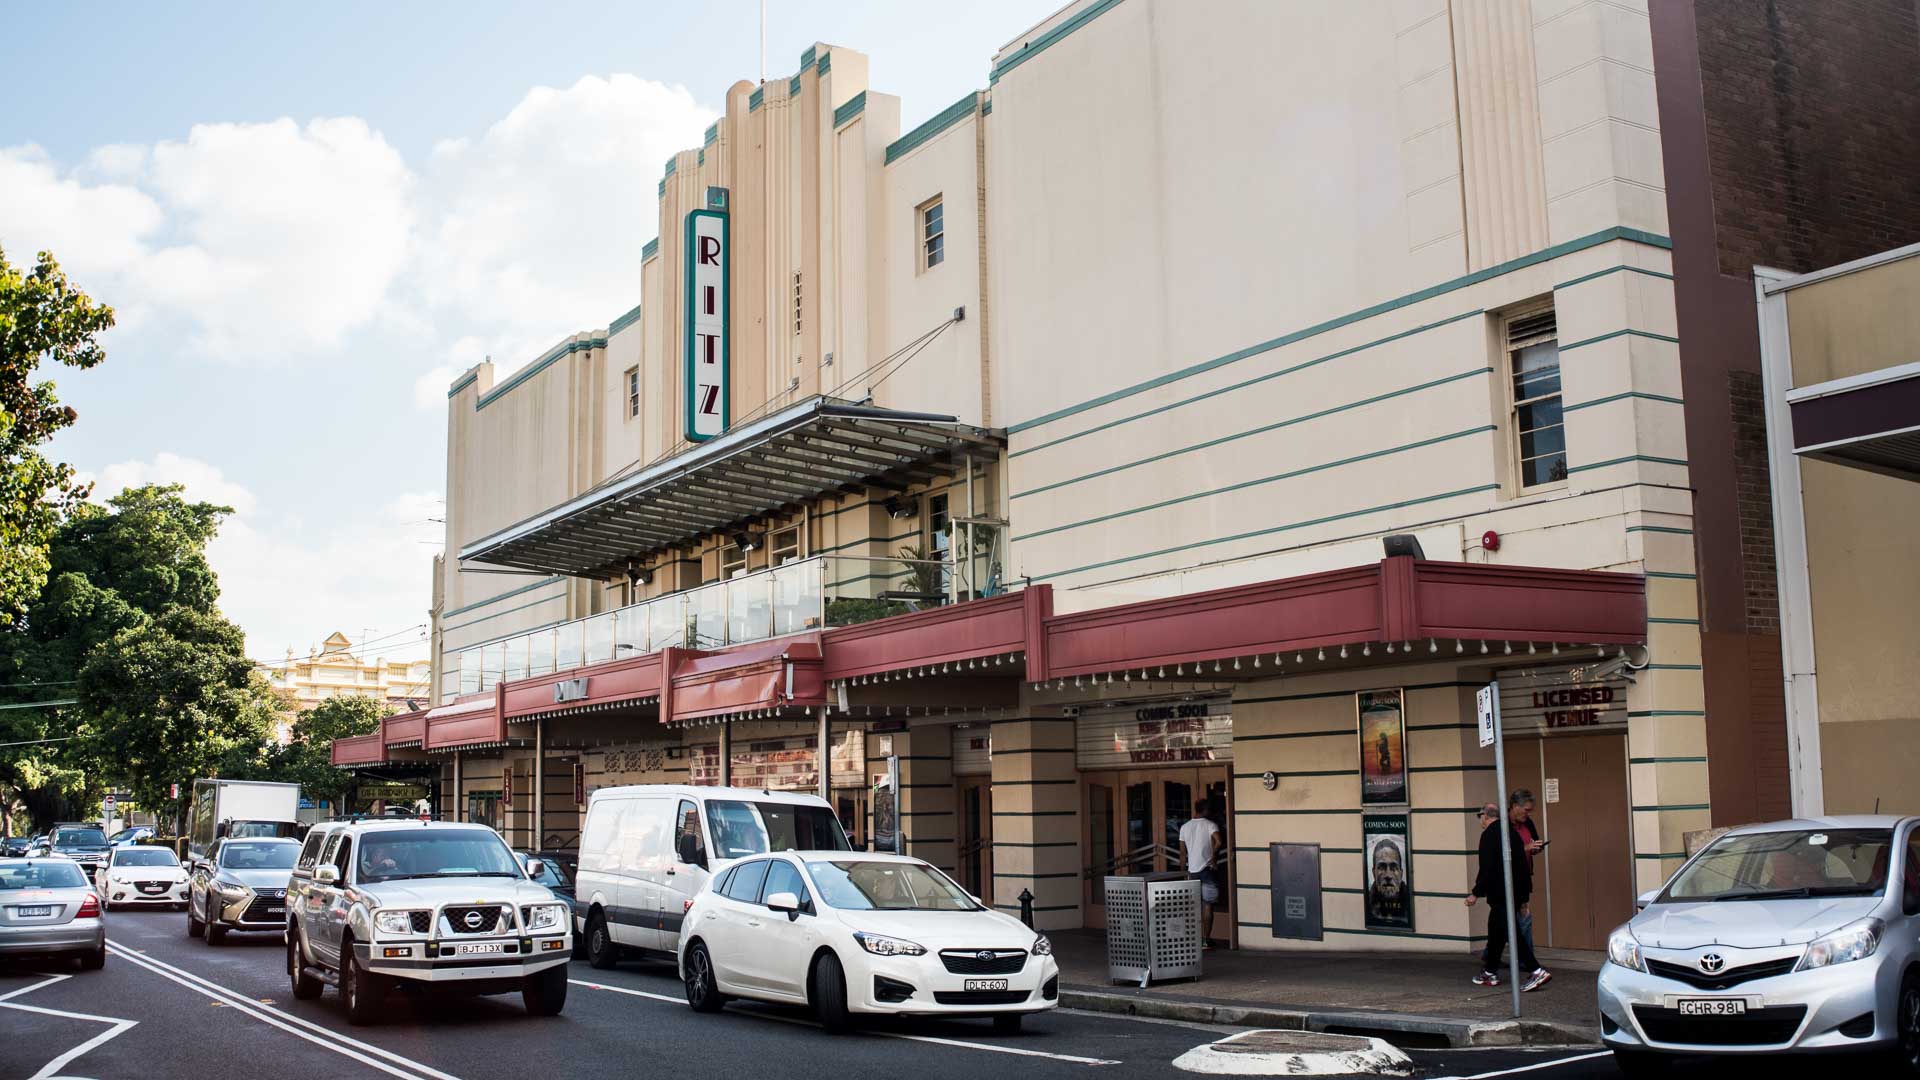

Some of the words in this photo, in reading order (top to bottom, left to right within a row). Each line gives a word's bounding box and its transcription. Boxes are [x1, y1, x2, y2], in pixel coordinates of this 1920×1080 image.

[696, 234, 721, 415] RITZ
[1533, 686, 1614, 708] LICENSED
[1136, 706, 1175, 721] COMING
[1178, 703, 1208, 718] SOON
[1544, 708, 1600, 728] VENUE
[1364, 821, 1389, 829] COMING
[1390, 821, 1406, 829] SOON
